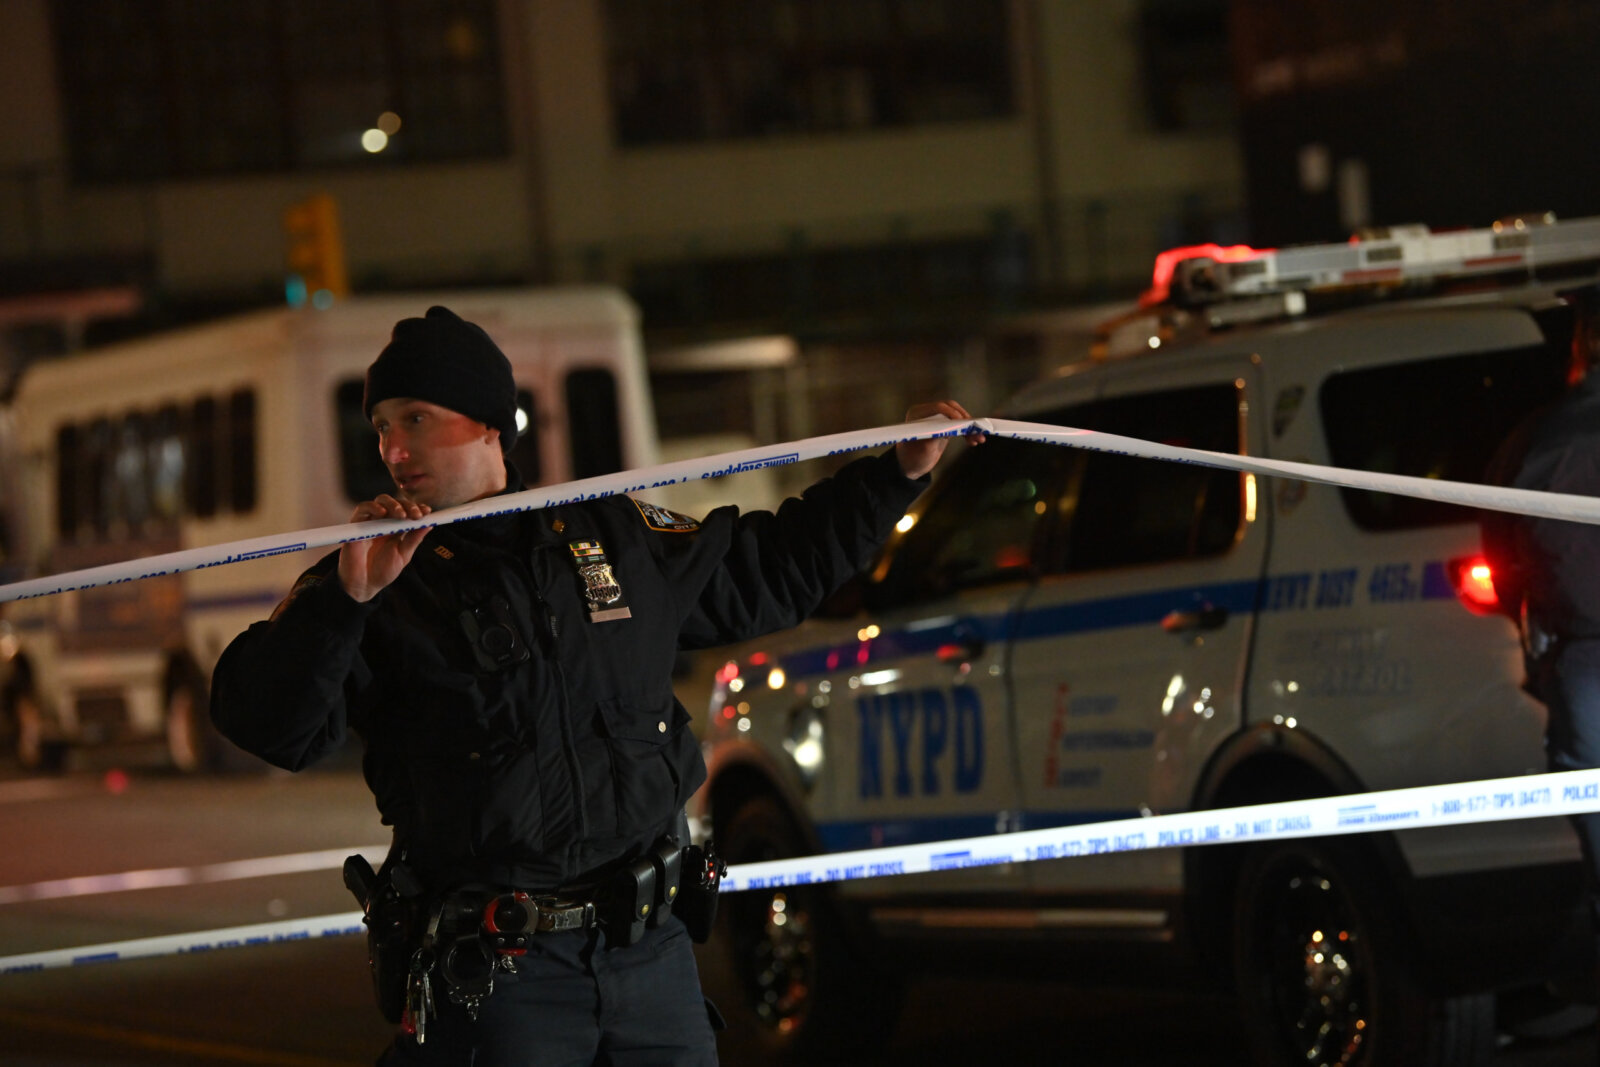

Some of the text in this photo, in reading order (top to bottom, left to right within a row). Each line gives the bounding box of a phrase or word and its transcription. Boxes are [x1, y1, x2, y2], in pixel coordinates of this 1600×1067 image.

[858, 684, 985, 798] NYPD
[1562, 782, 1599, 801] POLICE
[1157, 828, 1193, 848] POLICE
[1252, 819, 1272, 835] NOT
